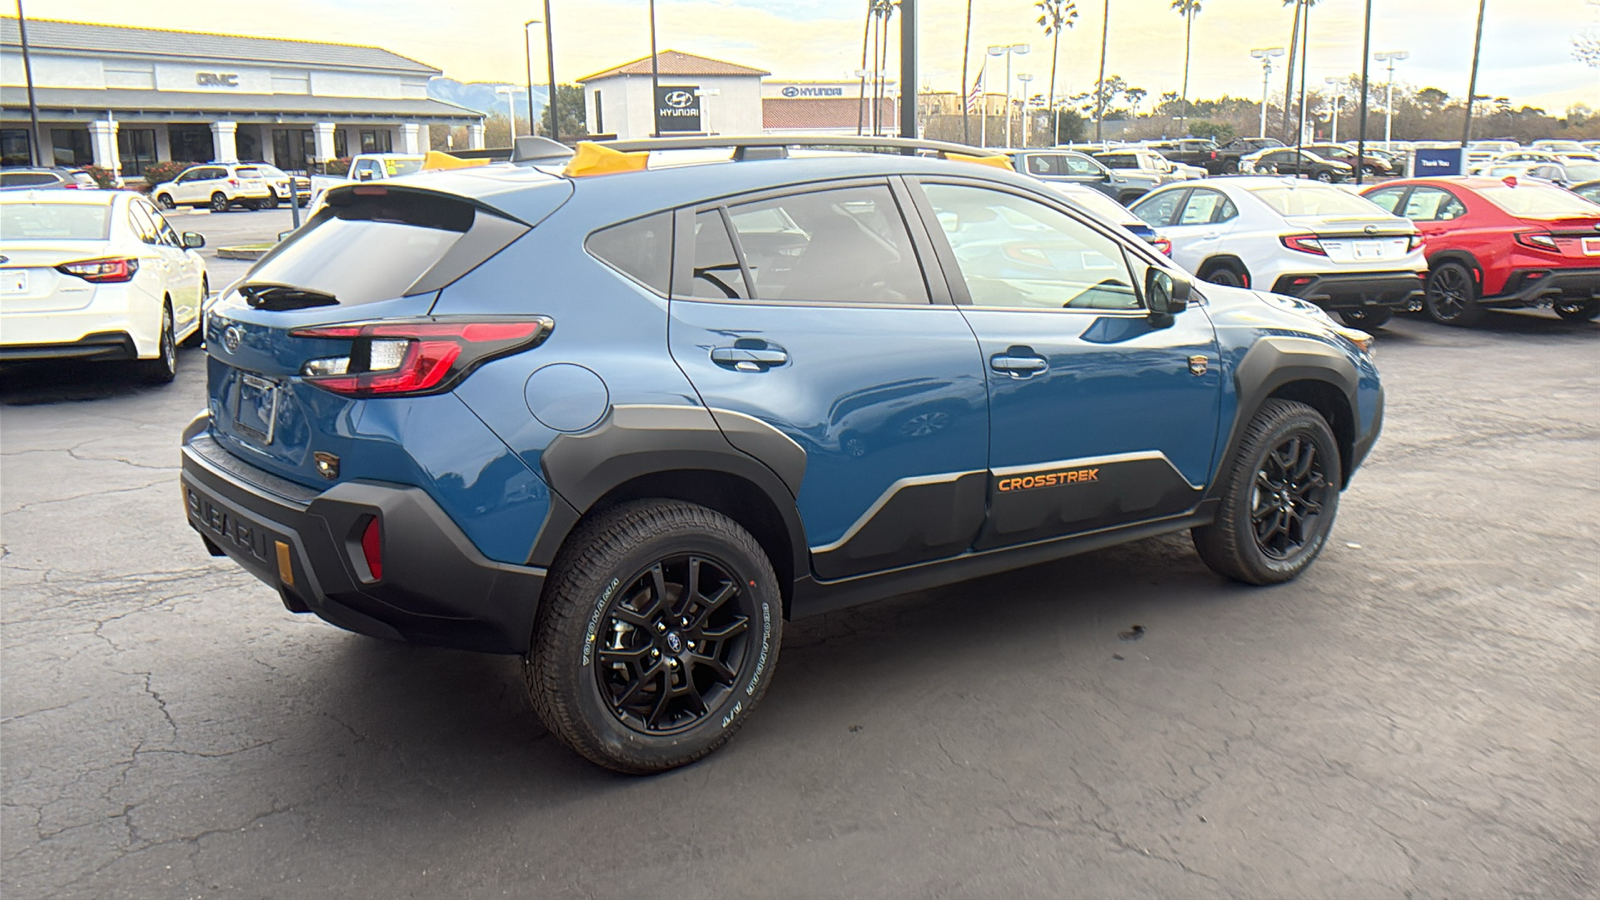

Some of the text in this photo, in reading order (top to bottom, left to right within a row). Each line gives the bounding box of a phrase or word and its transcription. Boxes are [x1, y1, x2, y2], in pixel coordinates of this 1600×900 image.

[196, 73, 239, 87] GMC
[800, 87, 842, 97] HYUNDAI
[659, 108, 699, 117] HYUNDAI
[998, 468, 1099, 492] CROSSTREK
[188, 488, 267, 562] SUBARU
[722, 700, 742, 728] A/T
